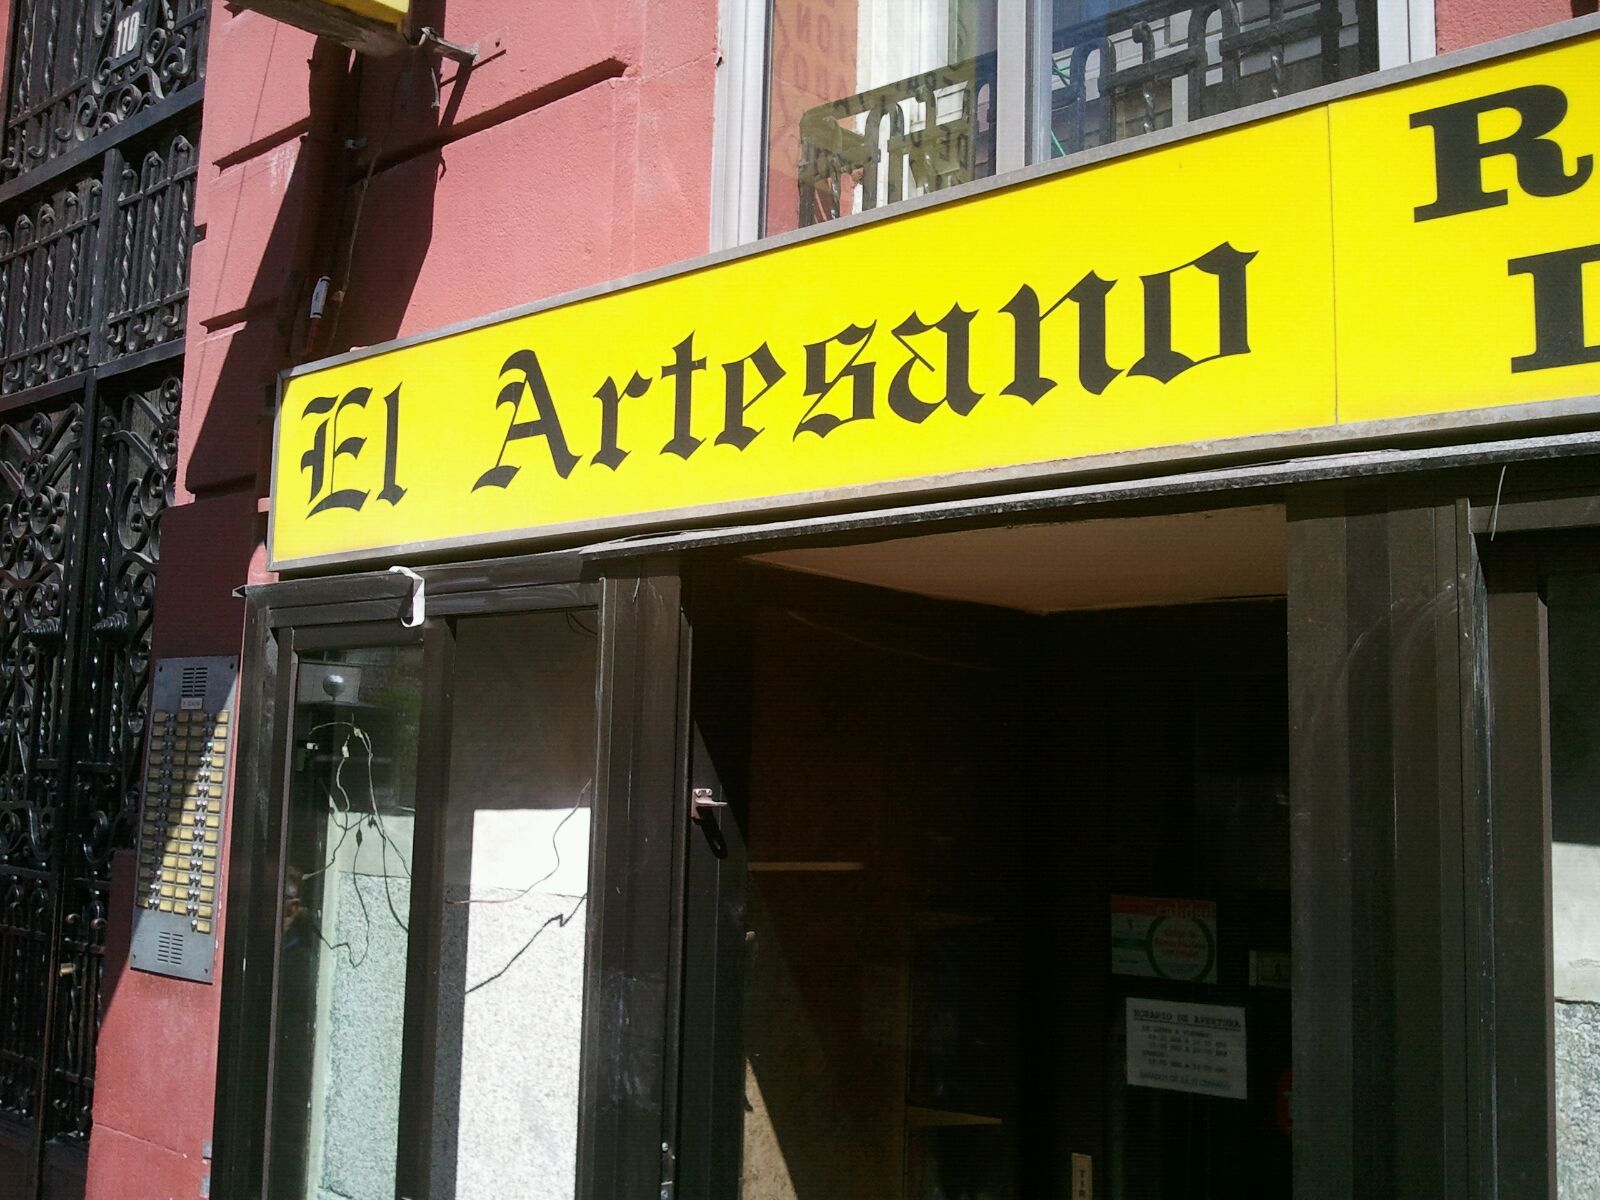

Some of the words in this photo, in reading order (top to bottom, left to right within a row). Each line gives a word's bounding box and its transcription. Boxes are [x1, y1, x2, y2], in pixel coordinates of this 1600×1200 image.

[115, 11, 141, 59] 110
[301, 383, 408, 519] El
[472, 242, 1259, 492] Artesano
[1134, 1009, 1173, 1019] HORARIO
[1193, 1015, 1242, 1027] APERTURA
